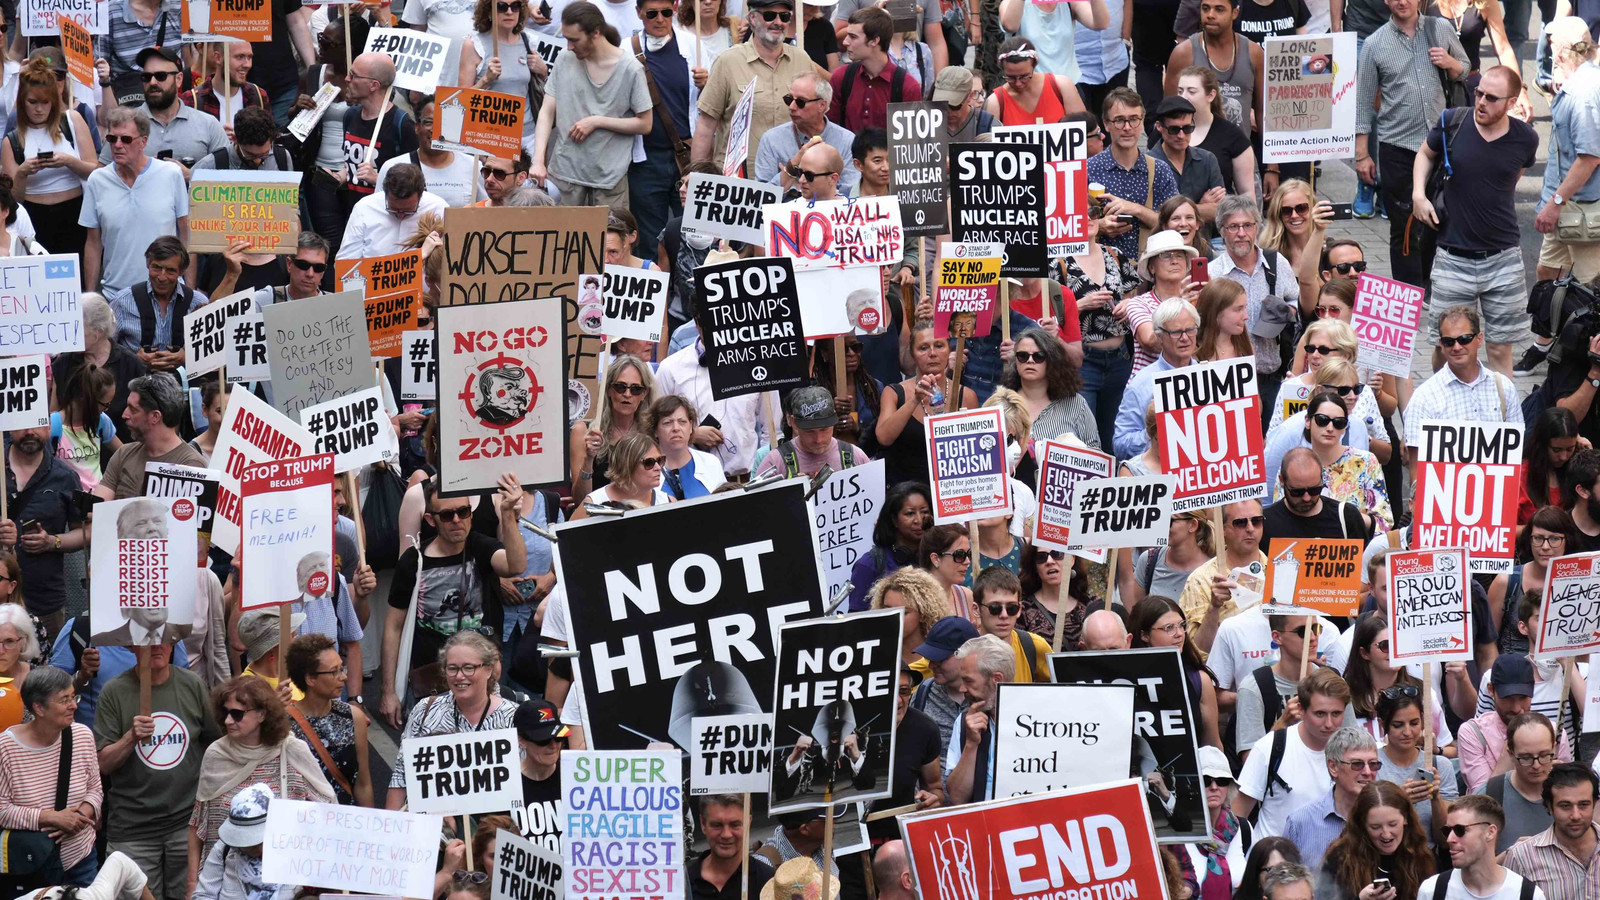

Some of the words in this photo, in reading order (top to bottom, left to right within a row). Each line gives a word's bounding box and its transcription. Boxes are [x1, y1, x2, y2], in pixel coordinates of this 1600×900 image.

[1241, 20, 1273, 32] DONALD
[1273, 16, 1295, 31] TRUMP
[370, 34, 443, 58] #DUMP
[1280, 41, 1317, 54] LONG
[1269, 56, 1300, 68] HARD
[1268, 82, 1334, 101] PADDINGTON
[470, 94, 521, 114] #DUMP
[1269, 102, 1291, 115] SAYS
[1293, 100, 1308, 115] NO
[1312, 100, 1325, 112] TO
[470, 109, 518, 127] TRUMP
[892, 109, 943, 140] STOP
[1273, 114, 1320, 129] TRUMP
[1264, 137, 1298, 147] Climate
[1300, 136, 1329, 145] Action
[1332, 134, 1354, 143] Now!
[1270, 146, 1350, 157] www.campaigncc.org
[894, 142, 942, 165] TRUMP'S
[895, 167, 943, 185] NUCLEAR
[957, 150, 1037, 181] STOP
[191, 186, 252, 203] CLIMATE
[254, 187, 299, 204] CHANGE
[694, 181, 777, 209] #DUMP
[897, 189, 919, 204] ARMS
[921, 187, 943, 203] RACE
[959, 185, 1036, 206] TRUMP'S
[222, 204, 236, 219] IS
[240, 204, 275, 220] REAL
[960, 209, 1039, 226] NUCLEAR
[190, 220, 226, 232] UNLIKE
[230, 220, 260, 232] YOUR
[263, 220, 290, 233] HAIR
[770, 211, 835, 260] NO
[834, 202, 890, 226] WALL
[834, 227, 864, 247] USA
[876, 225, 900, 244] NHS
[961, 230, 1000, 244] ARMS
[1004, 231, 1039, 246] RACE
[444, 230, 533, 276] WORSE
[533, 230, 606, 275] THAN
[835, 242, 900, 264] TRUMP
[1060, 244, 1086, 256] TRUMP
[371, 254, 420, 277] #DUMP
[943, 262, 966, 273] SAY
[967, 261, 983, 273] NO
[371, 270, 416, 291] TRUMP
[704, 265, 787, 302] STOP
[941, 273, 959, 284] TO
[960, 272, 997, 284] TRUMP
[1361, 275, 1422, 304] TRUMP
[35, 291, 77, 314] WITH
[937, 300, 951, 312] #1
[952, 299, 992, 312] RACIST
[940, 288, 988, 301] WORLD'S
[364, 295, 414, 318] #DUMP
[708, 297, 791, 326] TRUMP'S
[862, 312, 876, 320] STOP
[1356, 290, 1419, 327] FREE
[190, 297, 252, 341] #DUMP
[275, 329, 296, 345] DO
[302, 321, 323, 339] US
[324, 315, 354, 334] THE
[453, 330, 498, 354] NO
[503, 325, 549, 350] GO
[712, 321, 795, 347] NUCLEAR
[1355, 317, 1413, 351] ZONE
[280, 333, 356, 362] GREATEST
[716, 346, 757, 367] ARMS
[761, 342, 798, 361] RACE
[285, 356, 354, 381] COURTESY
[308, 376, 335, 392] AND
[1154, 362, 1254, 412] TRUMP
[308, 397, 379, 437] #DUMP
[934, 426, 955, 436] FIGHT
[956, 419, 995, 434] TRUMPISM
[1163, 397, 1254, 470] NOT
[1421, 424, 1521, 464] TRUMP
[458, 432, 544, 461] ZONE
[936, 437, 977, 460] FIGHT
[158, 466, 186, 477] Socialist
[243, 464, 280, 483] STOP
[283, 457, 333, 476] TRUMP
[938, 453, 993, 479] RACISM
[1048, 451, 1070, 465] FIGHT
[1069, 456, 1107, 473] TRUMPISM
[146, 474, 205, 498] DUMP
[269, 477, 304, 489] BECAUSE
[940, 480, 955, 489] Fight
[964, 478, 978, 487] jobs
[977, 476, 998, 484] homes
[952, 487, 976, 496] services
[941, 498, 961, 508] Young
[1079, 483, 1168, 511] #DUMP
[1206, 490, 1238, 507] AGAINST
[1238, 486, 1264, 499] TRUMP
[1421, 463, 1515, 526] NOT
[175, 503, 191, 511] STOP
[249, 507, 298, 530] FREE
[832, 498, 874, 524] LEAD
[943, 503, 973, 514] Socialists
[1080, 507, 1161, 534] TRUMP
[118, 539, 169, 553] RESIST
[248, 524, 317, 547] MELANIA!
[1156, 537, 1168, 546] FOA
[1418, 525, 1511, 554] WELCOME
[118, 553, 169, 567] RESIST
[1304, 543, 1359, 561] #DUMP
[1394, 558, 1419, 567] Young
[118, 567, 169, 580] RESIST
[1304, 562, 1356, 578] TRUMP
[1397, 564, 1434, 576] Socialists
[1484, 560, 1510, 571] TRUMP
[1555, 562, 1579, 572] Young
[1556, 568, 1592, 579] Socialists
[118, 580, 169, 594] RESIST
[603, 538, 775, 622] NOT
[1396, 575, 1457, 598] PROUD
[118, 594, 169, 608] RESIST
[1395, 590, 1463, 616] AMERICAN
[796, 639, 881, 676] NOT
[781, 670, 891, 711] HERE
[1014, 713, 1101, 746] Strong
[412, 738, 512, 773] #DUMP
[1012, 751, 1058, 774] and
[573, 756, 668, 783] SUPER
[415, 766, 510, 799] TRUMP
[569, 785, 681, 812] CALLOUS
[296, 808, 317, 824] US
[325, 810, 415, 834] PRESIDENT
[567, 813, 674, 839] FRAGILE
[271, 832, 314, 852] LEADER
[334, 838, 354, 856] THE
[355, 841, 386, 862] FREE
[389, 848, 433, 865] WORLD?
[571, 841, 677, 867] RACIST
[998, 813, 1132, 896] END
[289, 857, 326, 879] NOT
[330, 862, 364, 883] ANY
[369, 866, 409, 889] MORE
[499, 842, 563, 888] #DUMP
[572, 868, 678, 894] SEXIST
